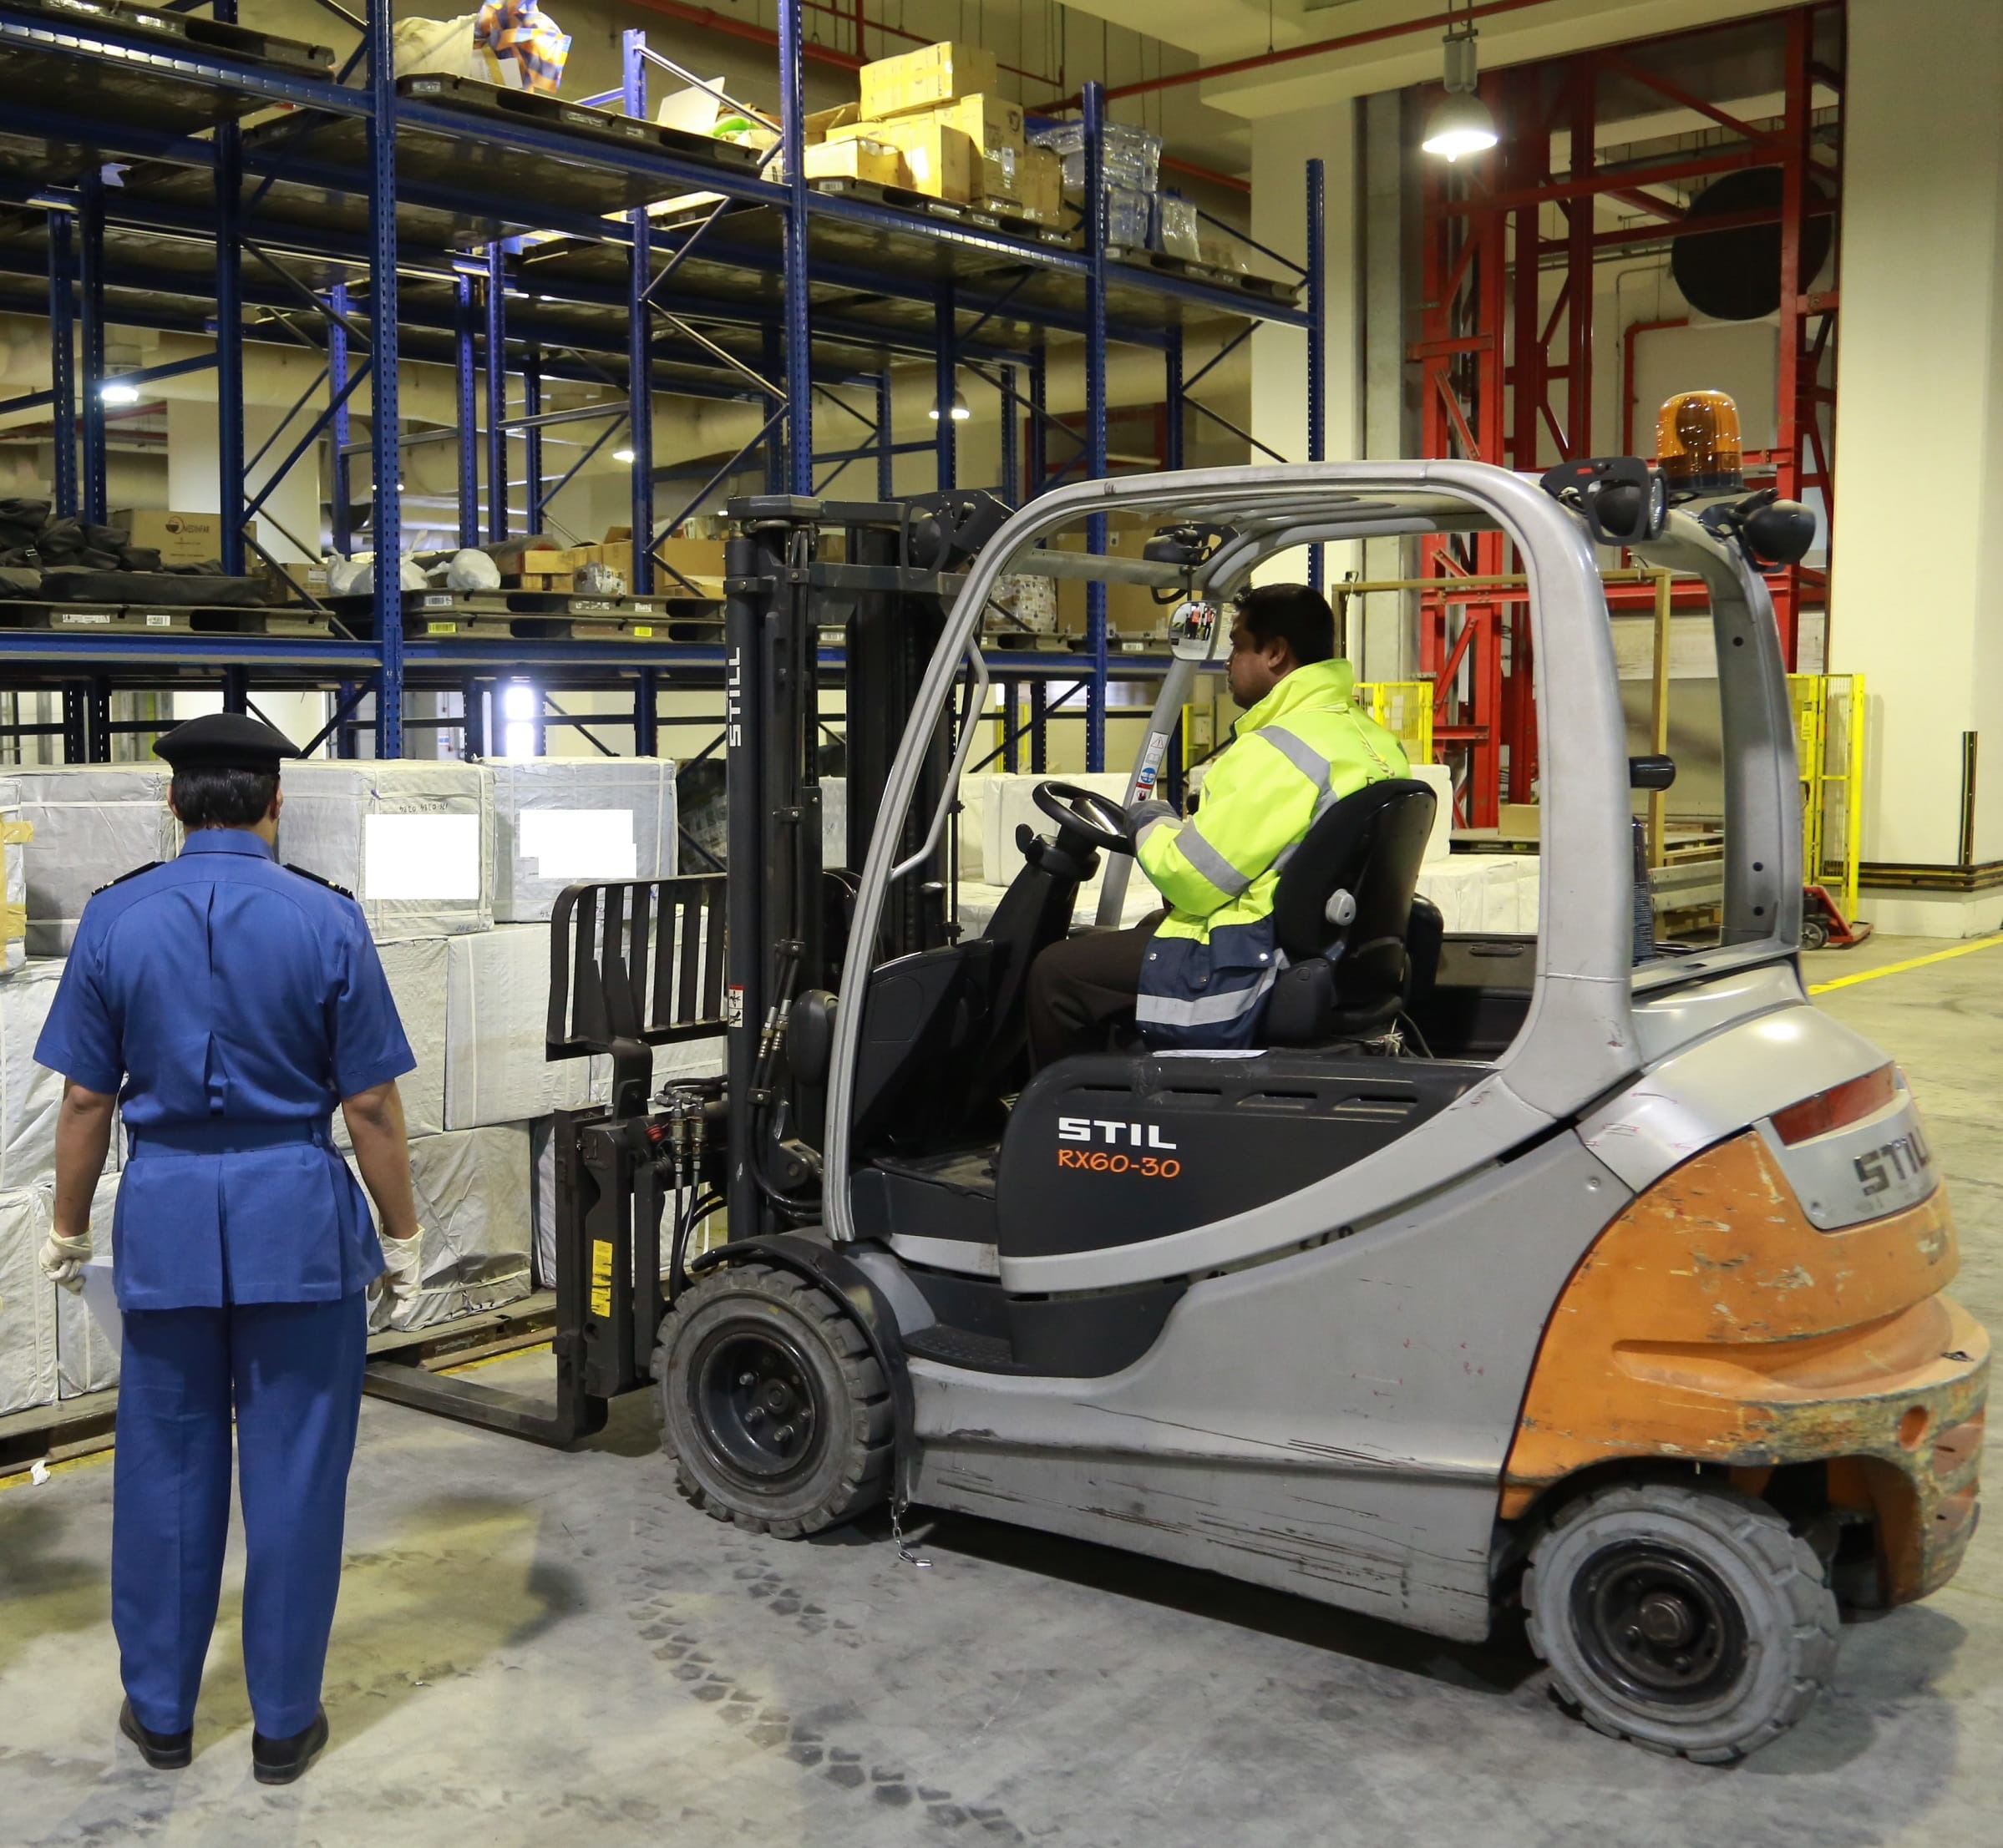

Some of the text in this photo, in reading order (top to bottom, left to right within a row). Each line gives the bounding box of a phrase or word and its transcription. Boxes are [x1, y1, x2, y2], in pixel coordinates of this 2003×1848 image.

[728, 647, 742, 747] STILL
[1058, 1117, 1177, 1150] STIL
[1057, 1148, 1181, 1178] RX60-30
